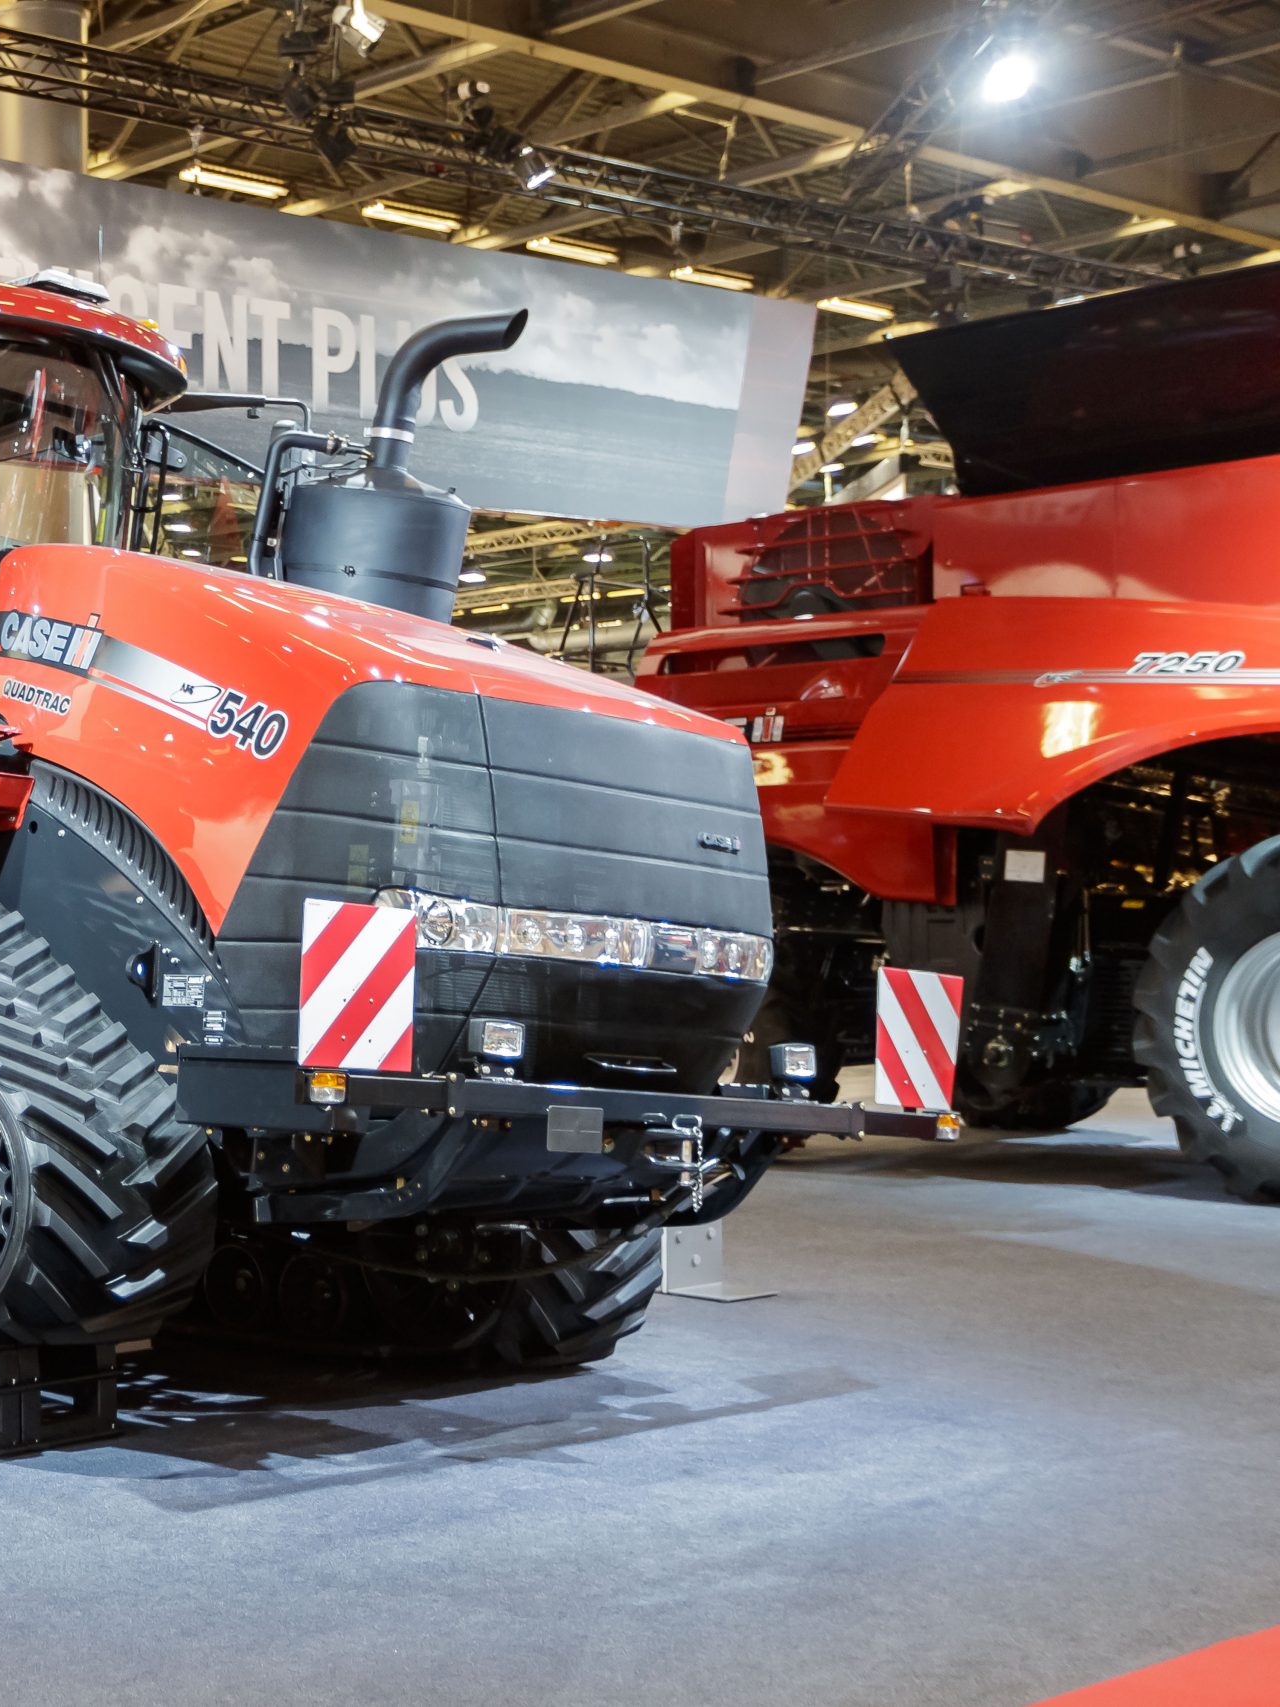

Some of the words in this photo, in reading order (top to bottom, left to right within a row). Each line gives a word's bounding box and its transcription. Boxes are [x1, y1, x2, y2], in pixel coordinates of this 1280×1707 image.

[0, 611, 71, 663] CASE
[1125, 650, 1246, 675] 7250
[2, 679, 71, 715] QUADTRAC
[207, 686, 289, 760] 540
[1173, 946, 1215, 1099] MICHELIN
